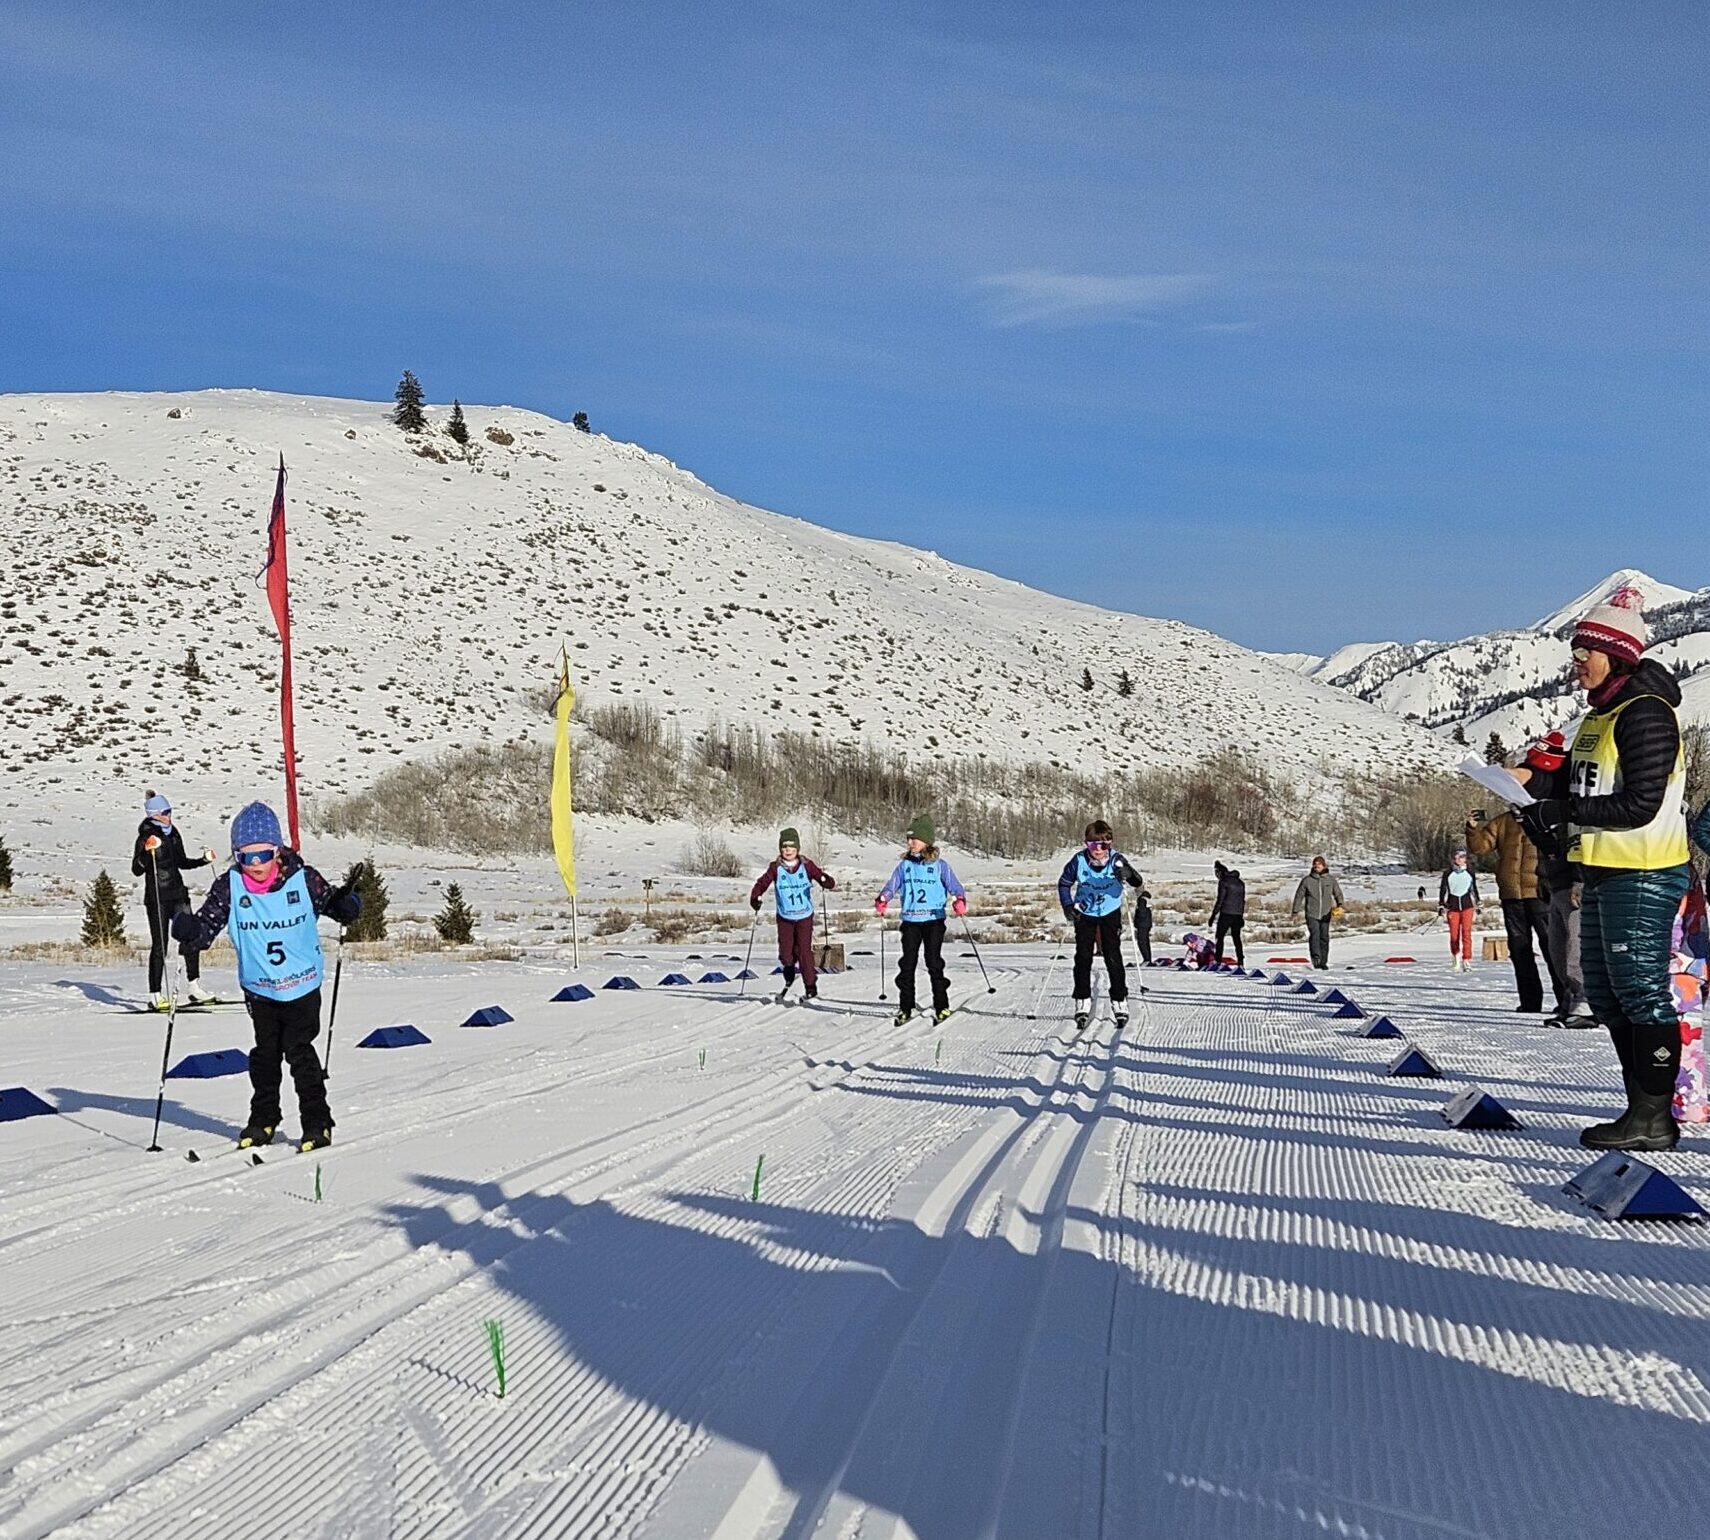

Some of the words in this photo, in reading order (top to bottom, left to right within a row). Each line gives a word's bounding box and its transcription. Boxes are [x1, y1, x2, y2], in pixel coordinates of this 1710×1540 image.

[788, 892, 803, 906] 11
[909, 888, 927, 904] 12
[262, 913, 307, 930] VALLEY
[267, 941, 287, 966] 5
